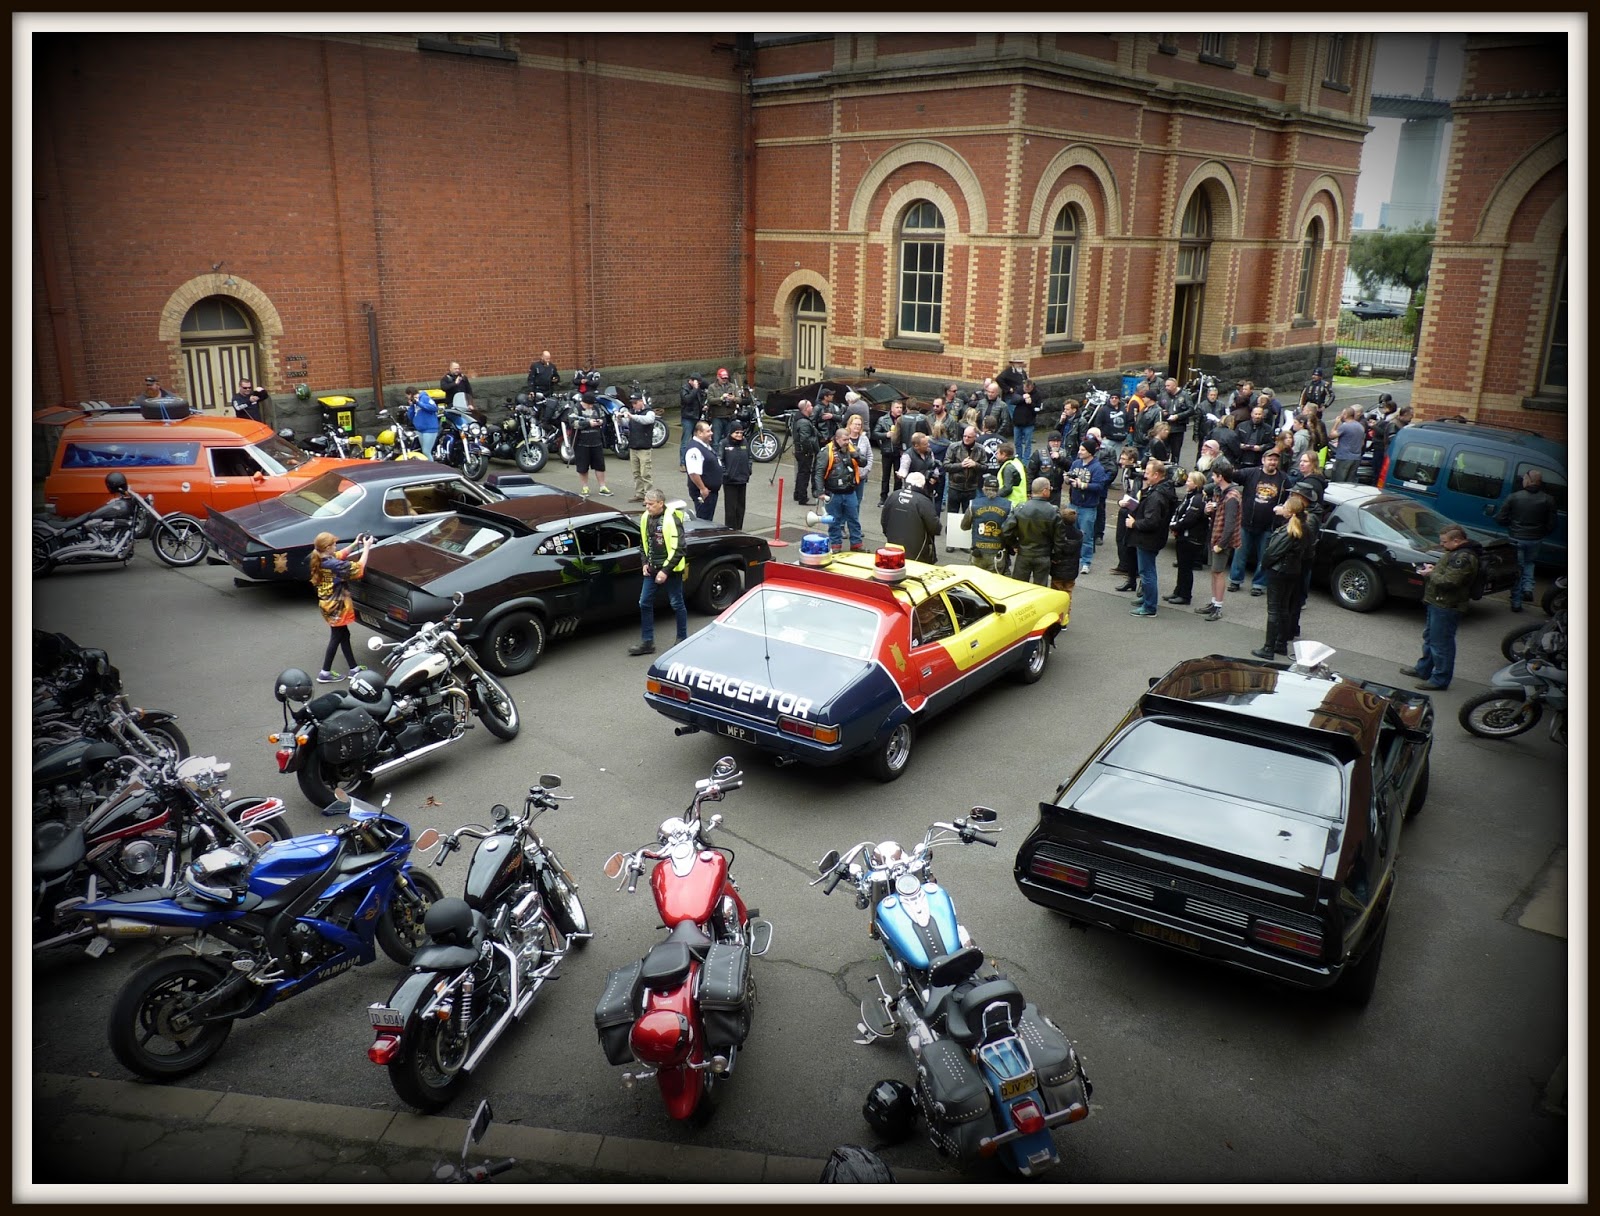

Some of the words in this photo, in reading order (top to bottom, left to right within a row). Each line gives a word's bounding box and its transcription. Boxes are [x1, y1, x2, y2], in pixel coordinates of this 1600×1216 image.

[666, 662, 813, 719] INTERCEPTOR
[727, 725, 745, 739] MFP
[318, 955, 361, 979] YAMAHA
